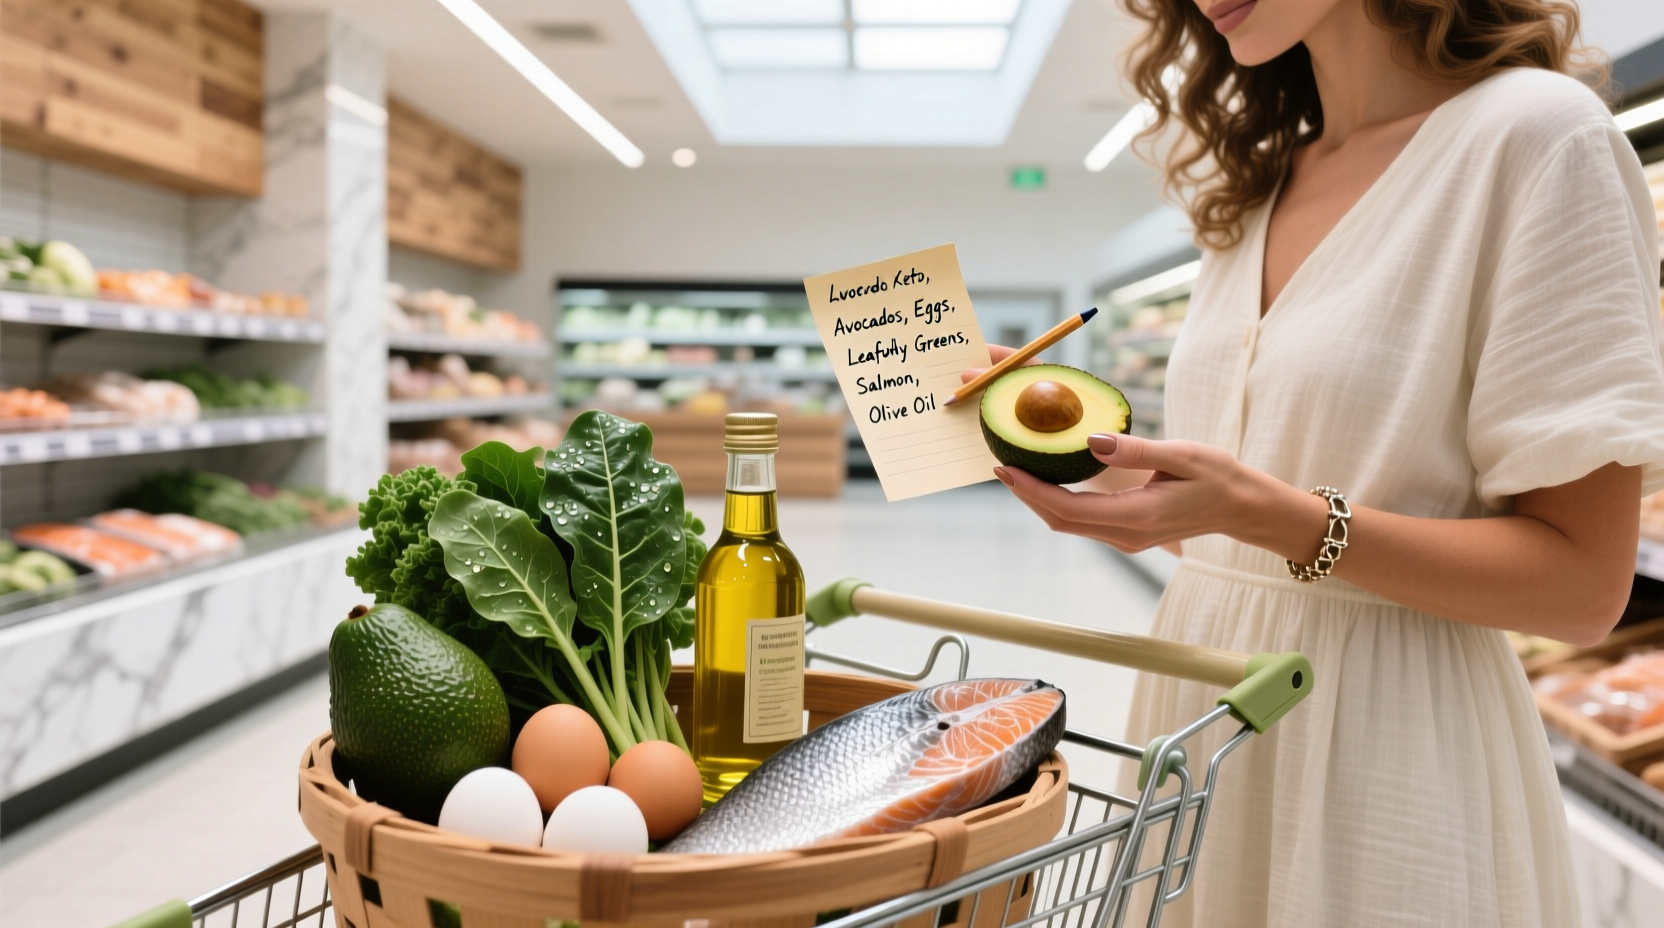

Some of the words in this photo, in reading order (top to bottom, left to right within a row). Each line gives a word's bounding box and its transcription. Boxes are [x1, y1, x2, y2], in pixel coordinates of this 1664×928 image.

[834, 307, 908, 337] Avocados,
[914, 298, 955, 325] Eggs,
[914, 331, 969, 353] Greens,
[856, 373, 920, 395] Salmon,
[869, 404, 909, 424] Olive
[913, 392, 936, 414] Oil
